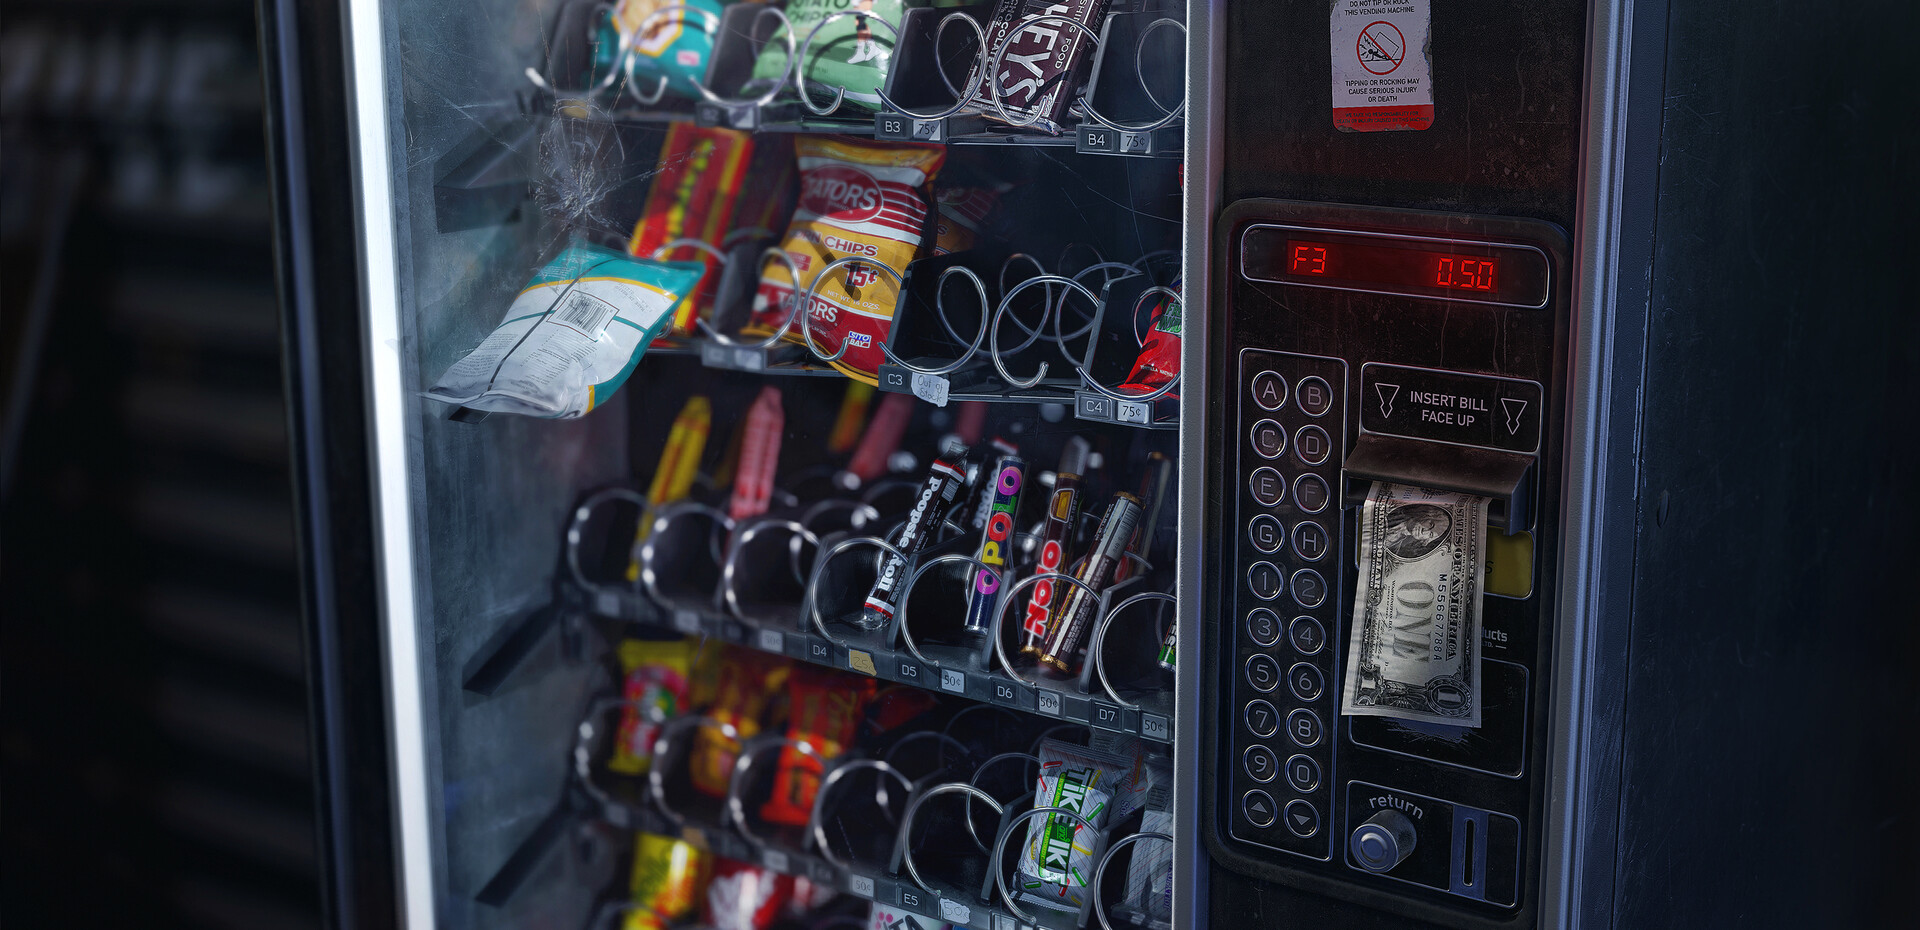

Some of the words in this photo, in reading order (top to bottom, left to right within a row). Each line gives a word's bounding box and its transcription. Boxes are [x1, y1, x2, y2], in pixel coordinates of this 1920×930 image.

[1053, 37, 1072, 69] FOOD
[885, 121, 901, 133] B3
[918, 124, 936, 135] 75¢
[1088, 133, 1105, 146] B4
[1126, 135, 1145, 147] 75¢
[803, 179, 878, 210] TATORS
[824, 235, 878, 257] CHIPS
[1293, 246, 1327, 274] F3
[1436, 257, 1494, 290] 0.50
[827, 290, 839, 298] NET
[849, 339, 864, 347] BAY
[850, 333, 870, 342] SITO
[888, 373, 903, 386] C3
[918, 375, 932, 387] Out
[935, 383, 943, 394] of
[920, 388, 942, 402] Stock
[1262, 381, 1277, 400] A
[1308, 386, 1322, 406] B
[1086, 400, 1103, 413] C4
[1122, 405, 1141, 417] 75¢
[1410, 391, 1456, 407] INSERT
[1459, 398, 1488, 411] BILL
[1421, 410, 1453, 425] FACE
[1457, 414, 1475, 427] UP
[1261, 430, 1275, 448] C
[1305, 435, 1320, 455] D
[1261, 477, 1274, 497] E
[1305, 483, 1319, 502] F
[900, 476, 943, 548] Poopsie
[1260, 524, 1273, 543] G
[1453, 507, 1465, 546] STATES
[1302, 531, 1317, 551] H
[1373, 541, 1384, 589] DOLLAR
[1452, 547, 1463, 574] OF
[1302, 578, 1315, 598] 2
[1257, 618, 1271, 636] 3
[1393, 582, 1433, 663] ONE
[1434, 574, 1447, 661] M55667788A
[1446, 574, 1462, 661] AMERICA
[1300, 626, 1313, 645] 4
[813, 645, 827, 657] D4
[902, 665, 917, 677] D5
[944, 675, 961, 687] 50¢
[1256, 664, 1269, 683] 5
[1299, 672, 1312, 690] 6
[997, 685, 1013, 699] D6
[1040, 696, 1058, 709] 50¢
[1099, 709, 1116, 722] D7
[1144, 719, 1163, 732] 50¢
[1255, 710, 1268, 728] 7
[1298, 719, 1311, 737] 8
[1254, 755, 1267, 772] 9
[1368, 794, 1424, 820] return
[855, 880, 871, 892] 50¢
[904, 894, 918, 906] E5
